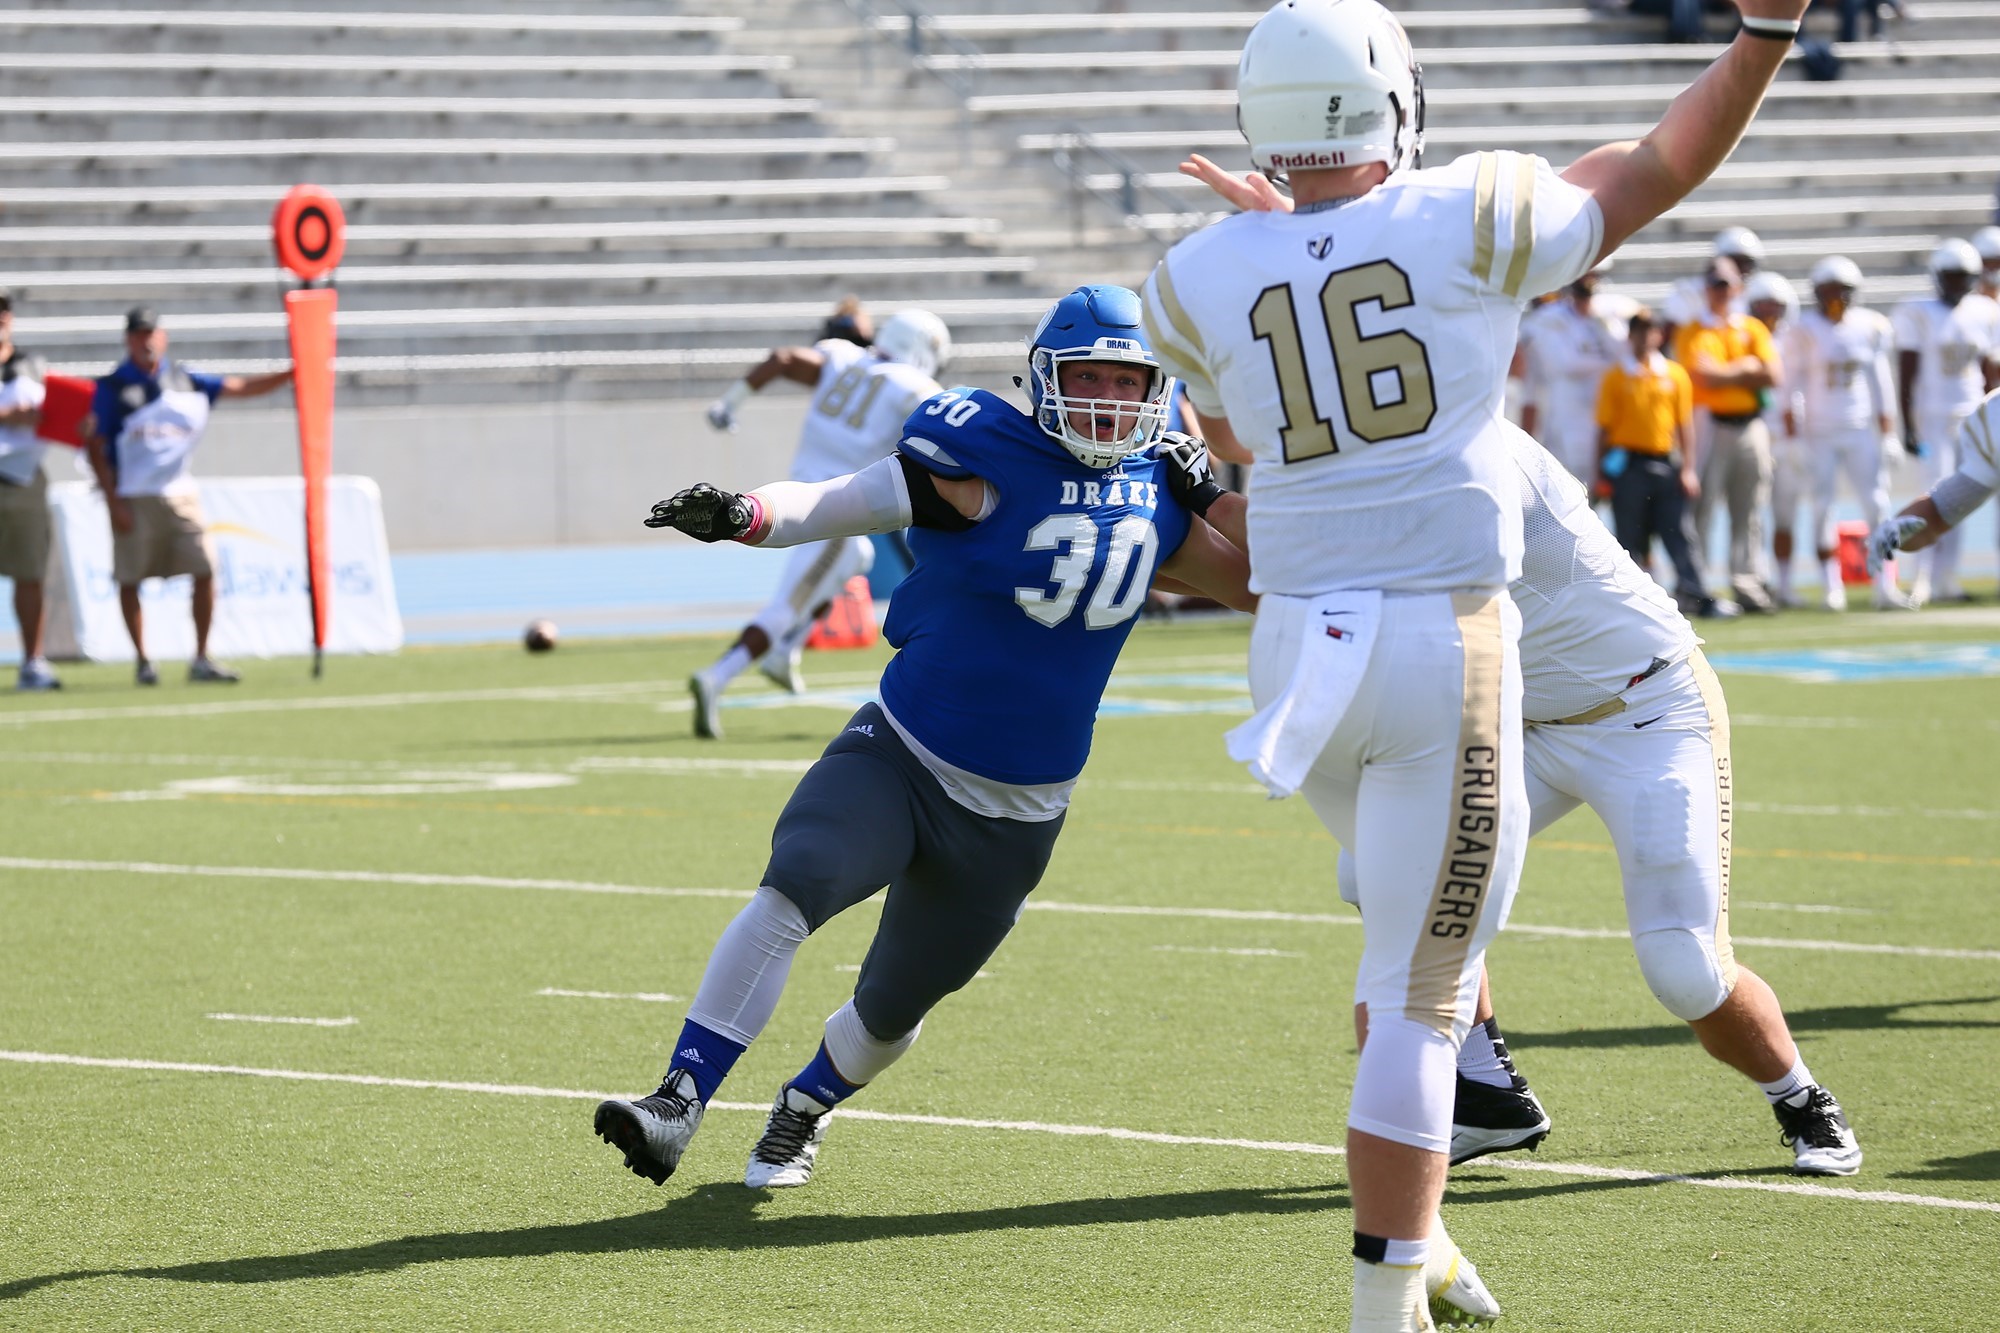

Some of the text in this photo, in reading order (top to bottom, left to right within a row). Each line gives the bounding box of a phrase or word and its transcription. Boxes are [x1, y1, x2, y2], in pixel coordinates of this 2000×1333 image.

[1270, 150, 1345, 168] Riddell
[1106, 339, 1131, 350] DRAKE
[1249, 258, 1437, 465] 16
[819, 367, 887, 430] 81
[925, 392, 982, 428] 30
[1059, 480, 1159, 511] DRAKE
[1014, 513, 1160, 631] 30
[1430, 746, 1497, 939] CRUSADERS
